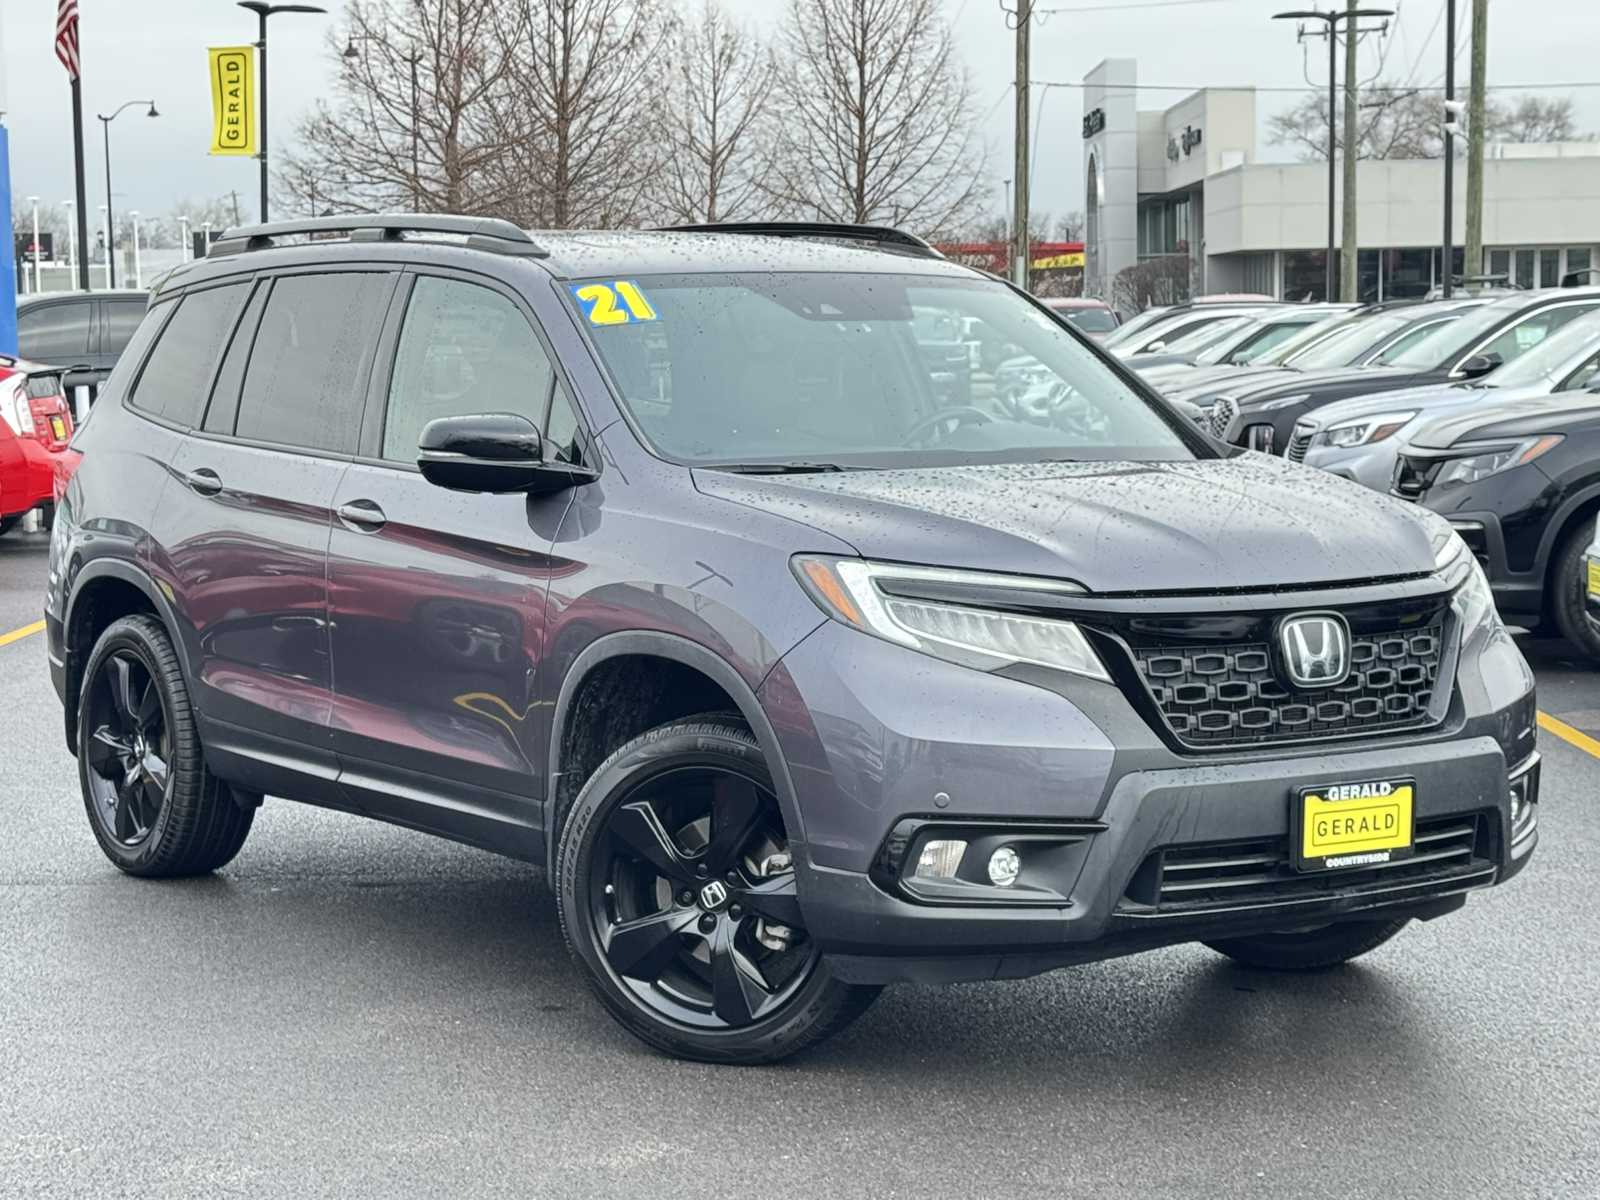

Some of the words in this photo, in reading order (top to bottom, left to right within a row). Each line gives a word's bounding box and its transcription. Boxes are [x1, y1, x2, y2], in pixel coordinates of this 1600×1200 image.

[226, 61, 240, 140] GERALD
[576, 281, 657, 325] 21
[1328, 781, 1392, 802] GERALD
[1317, 813, 1395, 837] GERALD
[1326, 851, 1390, 867] COUNTRYSIDE
